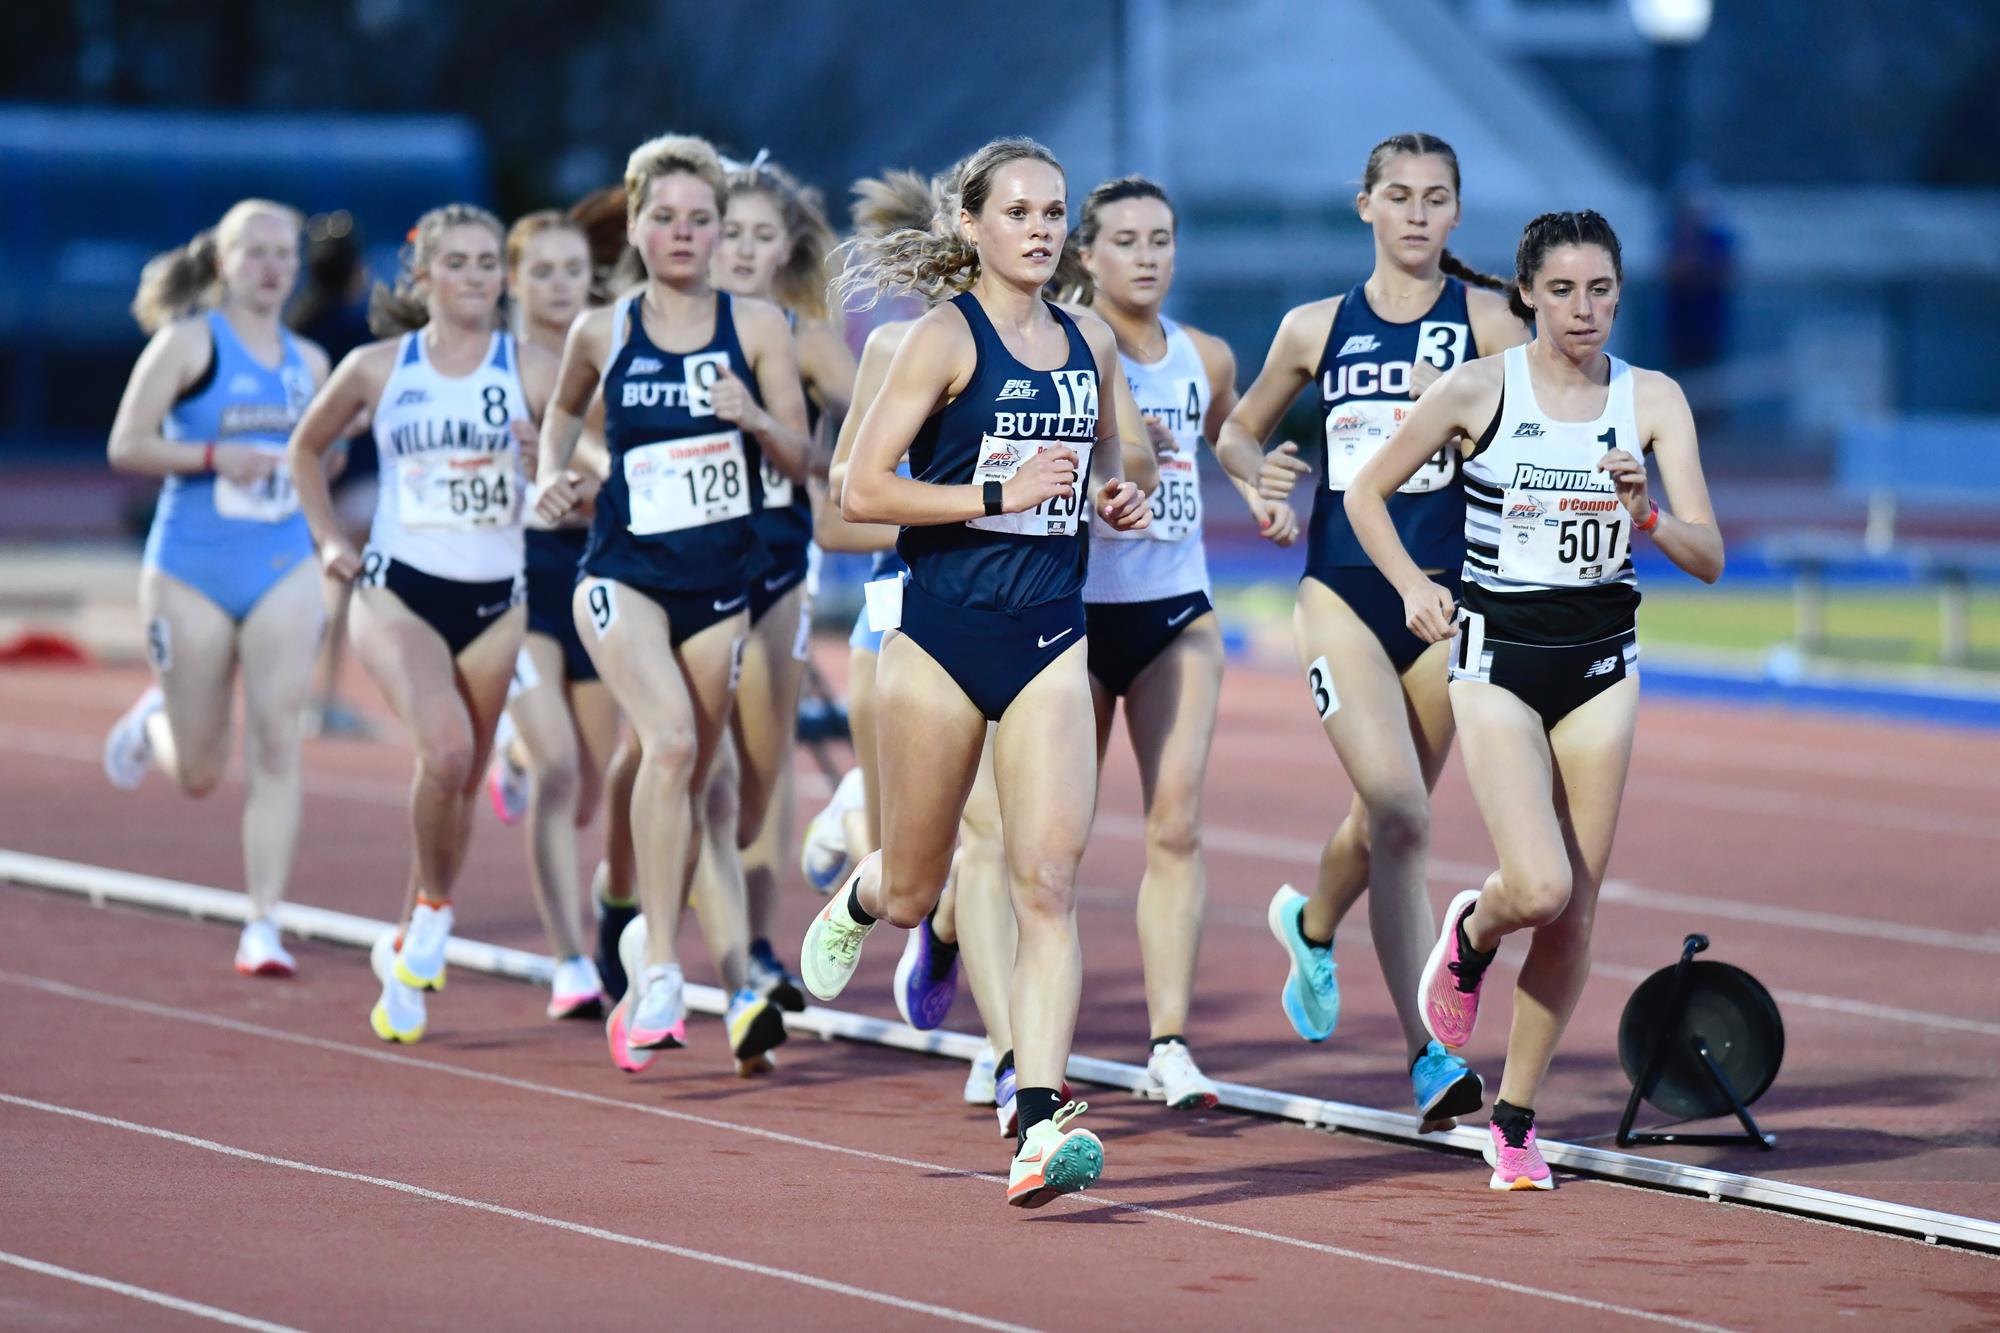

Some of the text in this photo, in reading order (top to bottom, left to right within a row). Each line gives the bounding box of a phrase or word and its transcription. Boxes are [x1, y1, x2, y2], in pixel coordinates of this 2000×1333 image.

[1423, 326, 1457, 372] 3
[998, 388, 1040, 397] EAST
[1004, 379, 1032, 389] BIG
[1057, 372, 1096, 416] 12
[1323, 361, 1414, 401] UCO
[482, 385, 509, 428] 8
[993, 412, 1096, 437] BUTLER
[1186, 381, 1201, 430] 4
[1518, 422, 1541, 430] BIG
[1513, 429, 1547, 437] EAST
[449, 474, 509, 515] 594
[682, 460, 741, 506] 128
[1151, 481, 1197, 521] 355
[1512, 504, 1538, 512] BIG
[1558, 498, 1619, 511] O'Connor
[1558, 519, 1621, 564] 501
[588, 586, 611, 629] 9
[1458, 615, 1471, 670] 1
[1308, 667, 1330, 718] 3
